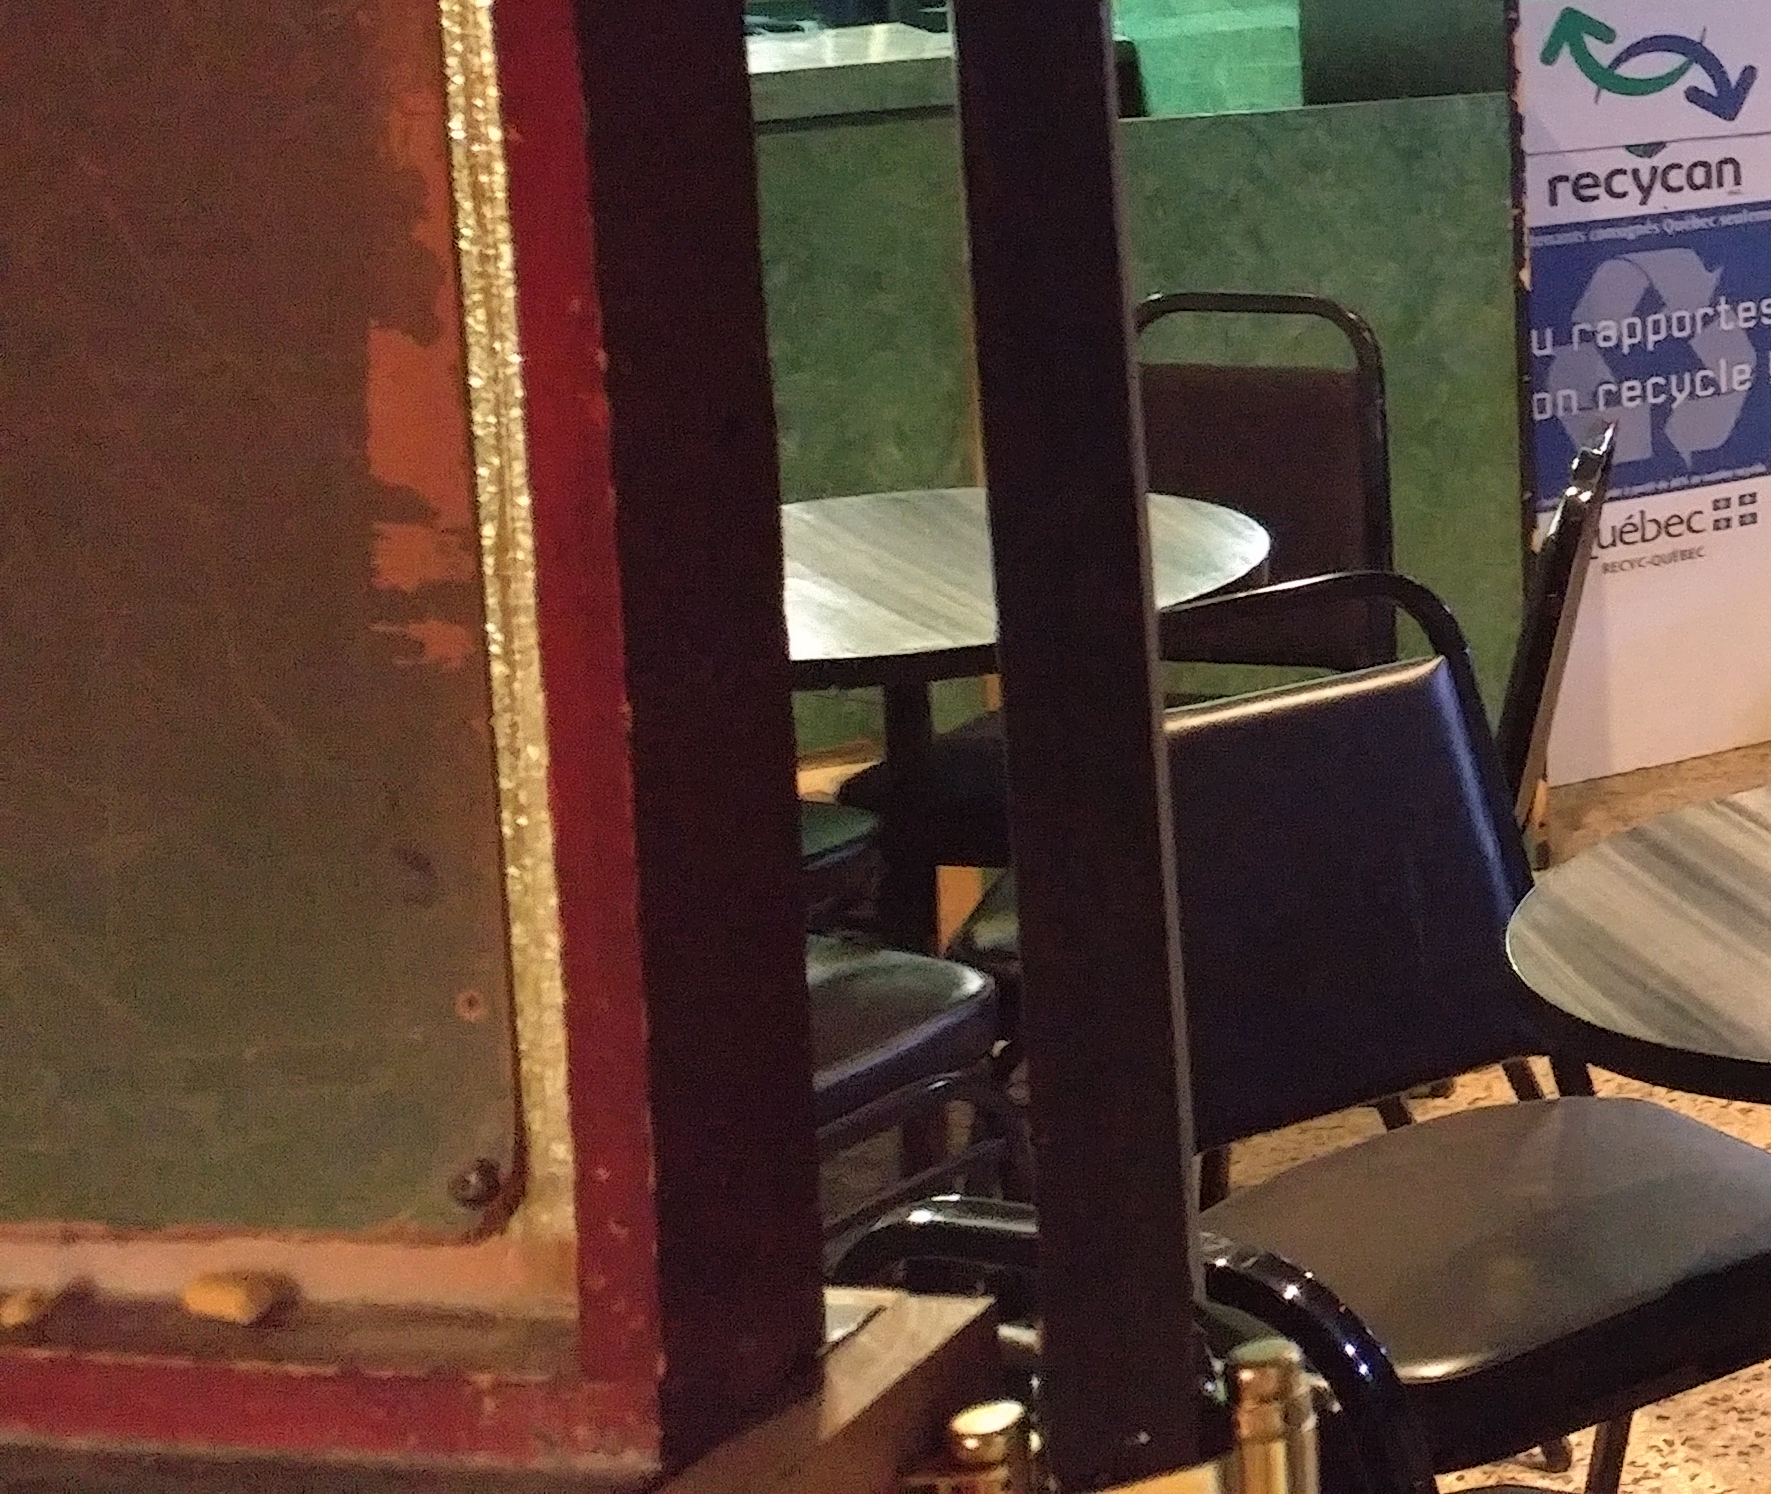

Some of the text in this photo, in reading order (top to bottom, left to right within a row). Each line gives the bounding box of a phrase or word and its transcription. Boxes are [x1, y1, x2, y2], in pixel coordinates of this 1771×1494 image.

[1547, 156, 1743, 208] recycan
[1530, 327, 1554, 357] u
[1532, 388, 1578, 421] on
[1597, 358, 1753, 412] recycle
[1597, 509, 1707, 550] uébec
